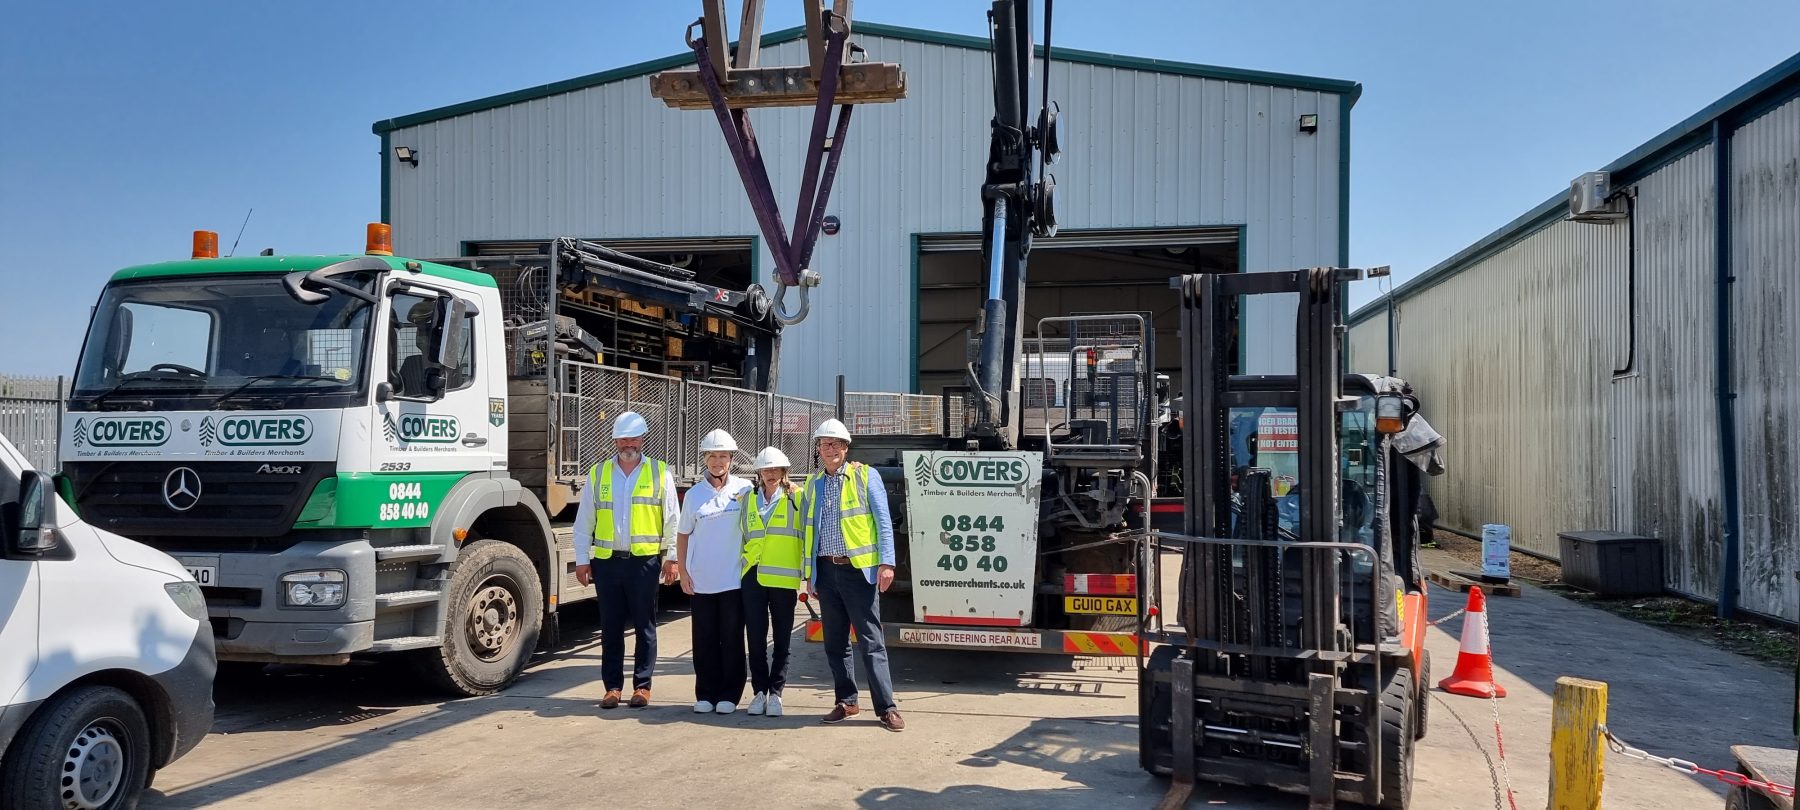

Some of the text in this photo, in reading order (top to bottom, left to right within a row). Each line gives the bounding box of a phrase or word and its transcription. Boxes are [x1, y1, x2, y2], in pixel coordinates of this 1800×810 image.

[490, 402, 504, 413] 175
[93, 421, 166, 441] COVERS
[223, 418, 305, 440] COVERS
[402, 417, 457, 438] COVERS
[1261, 440, 1276, 448] NOT
[380, 462, 411, 471] 2533
[940, 460, 1023, 481] COVERS
[389, 483, 422, 500] 0844
[957, 489, 985, 497] Builders
[380, 502, 428, 520] 858 40 40
[941, 515, 1004, 532] 0844
[949, 535, 996, 552] 858
[937, 554, 1008, 572] 40 40
[187, 569, 210, 583] AO
[920, 578, 1025, 589] coversmerchants.co.uk
[1073, 598, 1132, 612] GU10 GAX
[904, 631, 1037, 646] CAUTION STEERING REAR AXLE
